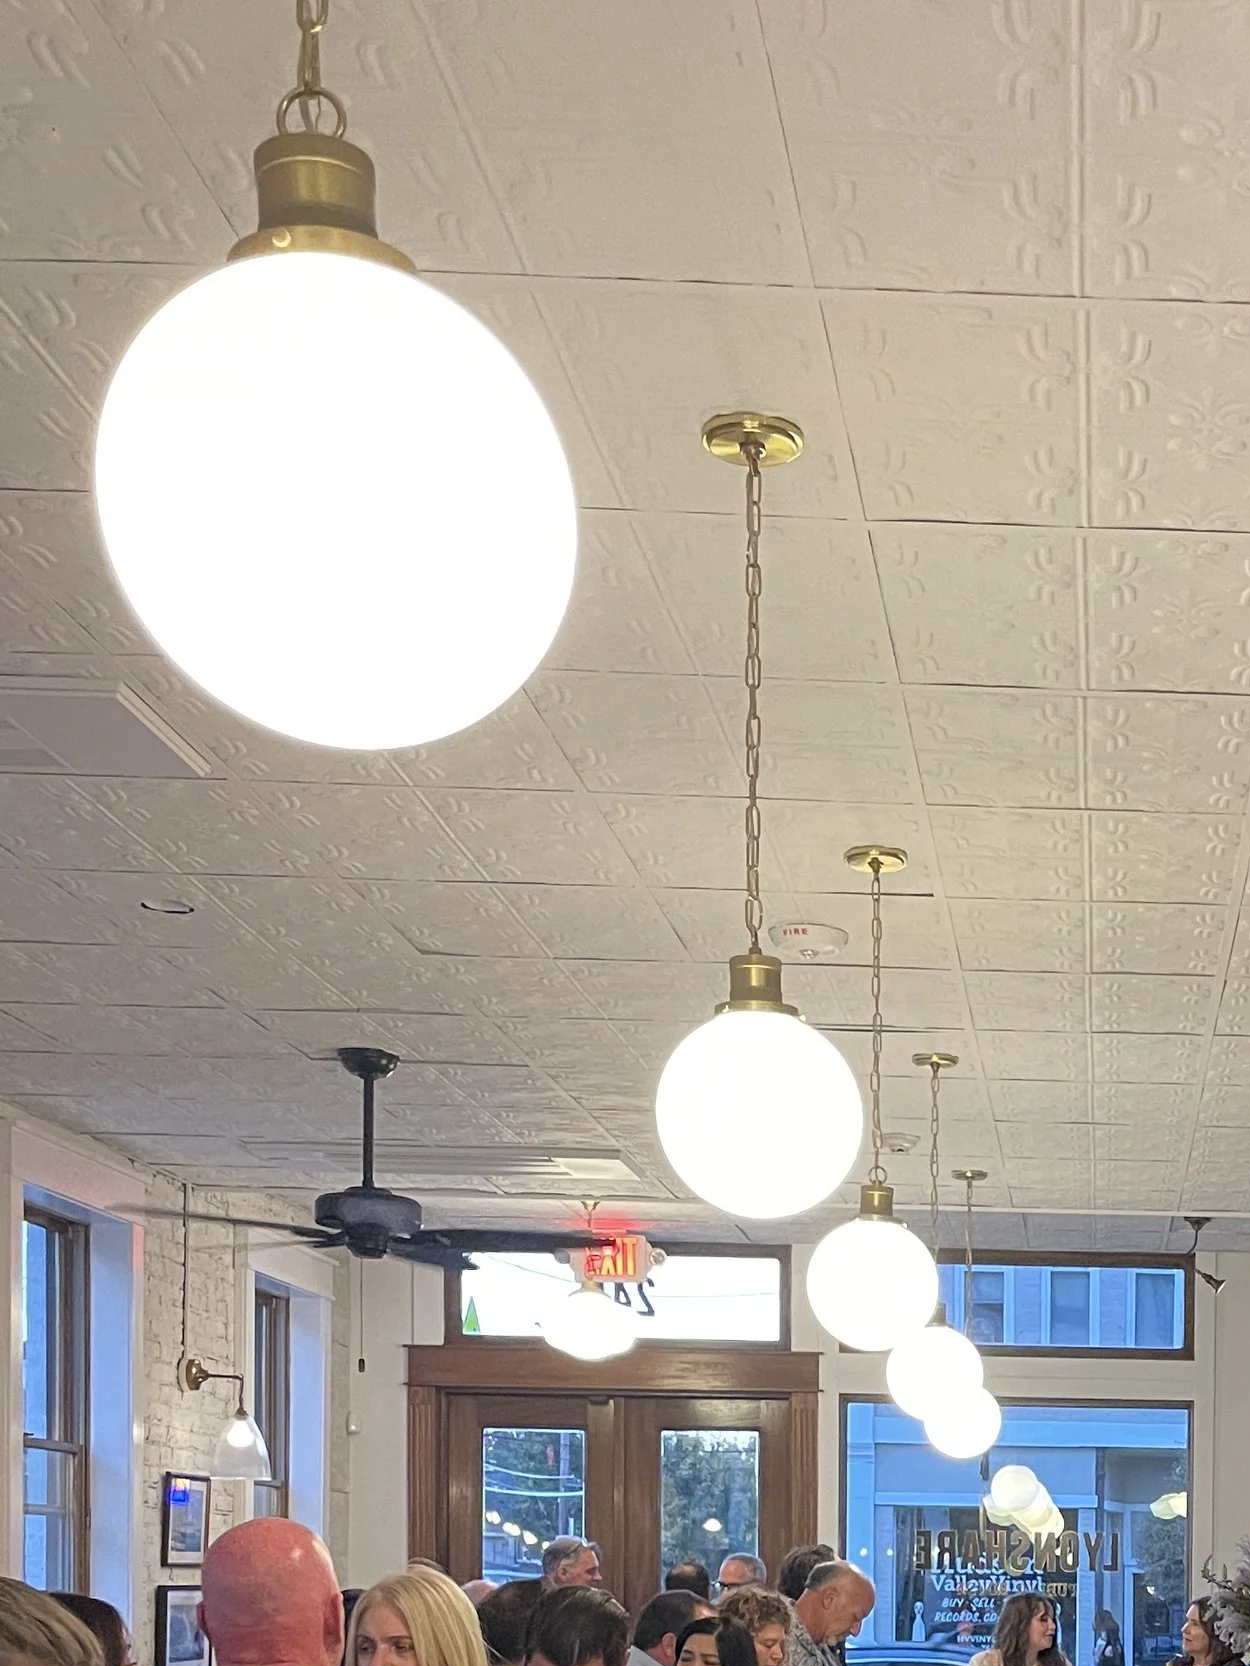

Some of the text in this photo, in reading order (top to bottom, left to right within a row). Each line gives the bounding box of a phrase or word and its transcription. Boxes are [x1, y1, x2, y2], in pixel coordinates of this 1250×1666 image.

[782, 927, 809, 937] FIRE
[941, 1597, 995, 1609] BUY SELL
